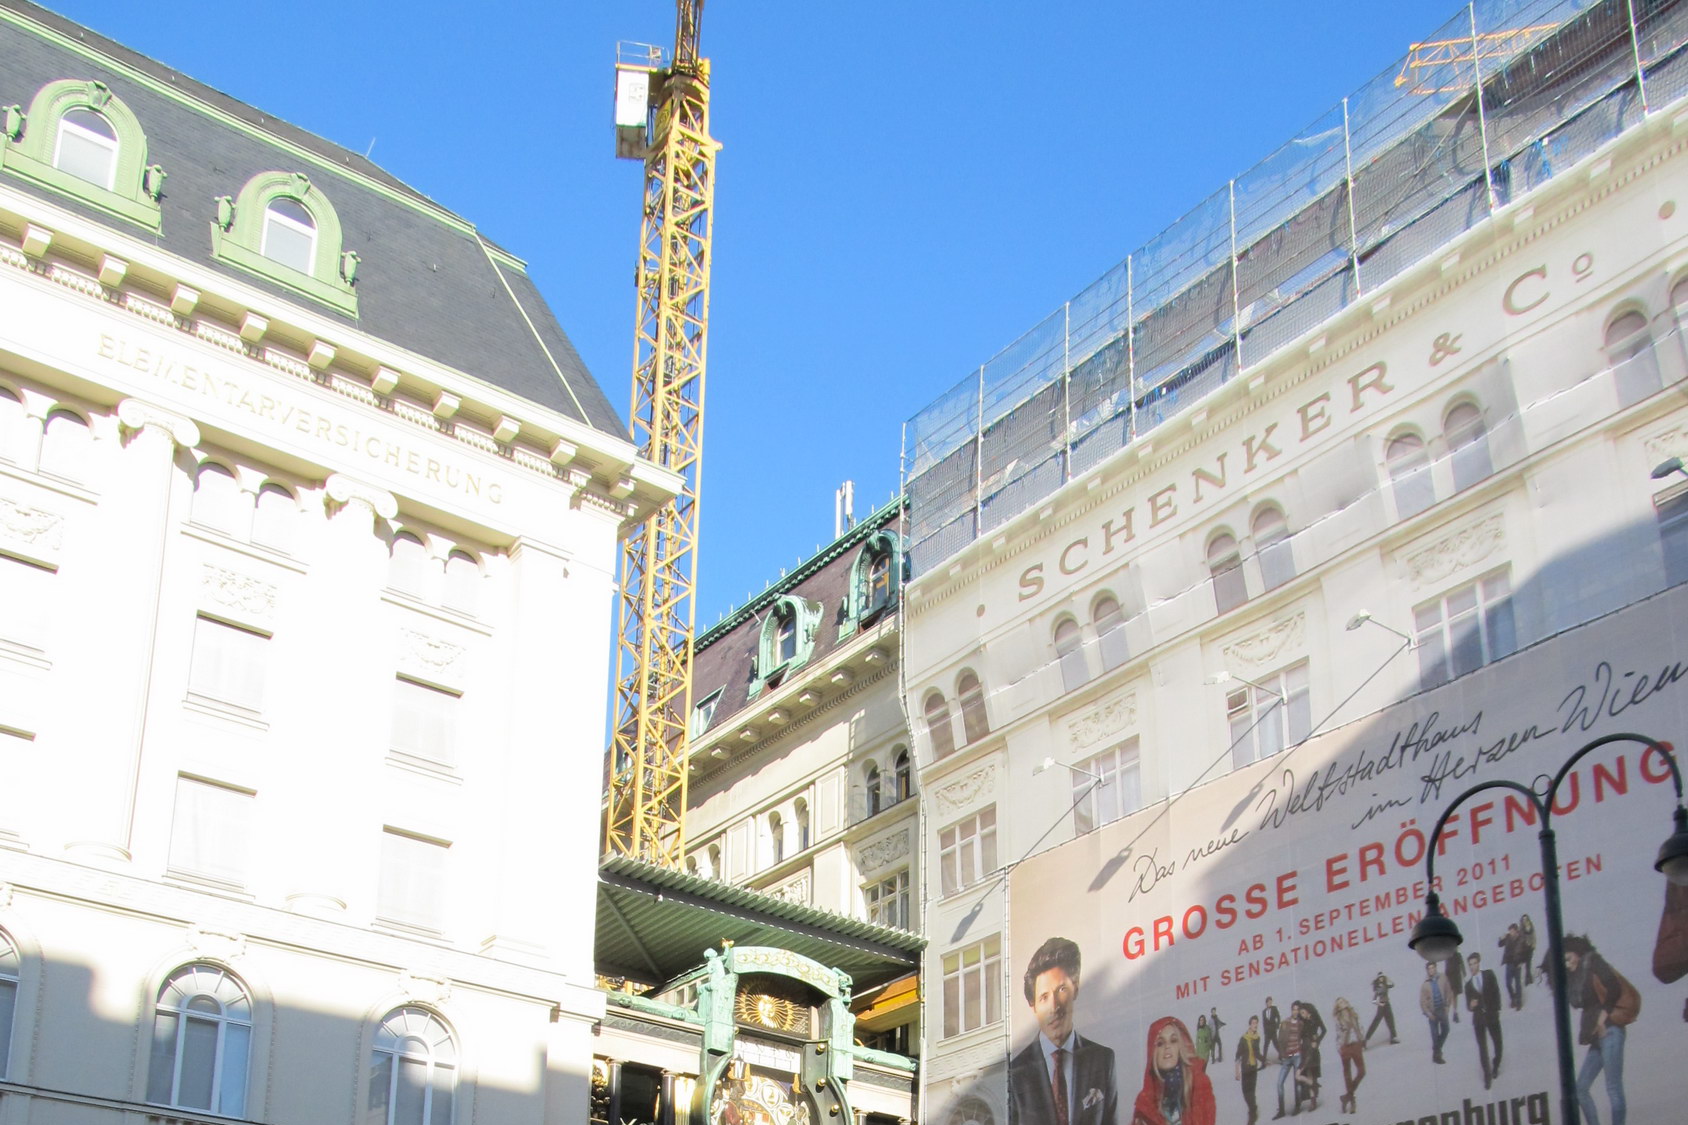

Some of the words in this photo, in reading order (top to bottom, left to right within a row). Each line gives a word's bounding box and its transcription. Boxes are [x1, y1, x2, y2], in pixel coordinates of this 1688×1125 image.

[95, 331, 506, 506] ELEMENTARVERSICHERUNG
[1017, 360, 1395, 604] SCHENKER
[1428, 331, 1464, 367] &
[1122, 869, 1300, 961] GROSSE
[1325, 740, 1677, 894] ERÖFFNUNG
[1127, 847, 1176, 904] Das
[1182, 828, 1250, 871] neue
[1256, 710, 1483, 831] Weltstadthaus
[1351, 792, 1413, 830] im
[1420, 724, 1558, 804] Herzen
[1175, 975, 1211, 1001] MIT
[1220, 909, 1423, 987] SENSATIONELLEN
[1437, 853, 1603, 919] ANGEBOEN
[1237, 932, 1264, 956] AB
[1275, 926, 1292, 945] 1.
[1298, 875, 1444, 936] SEPTEMBER
[1456, 853, 1511, 887] 2011
